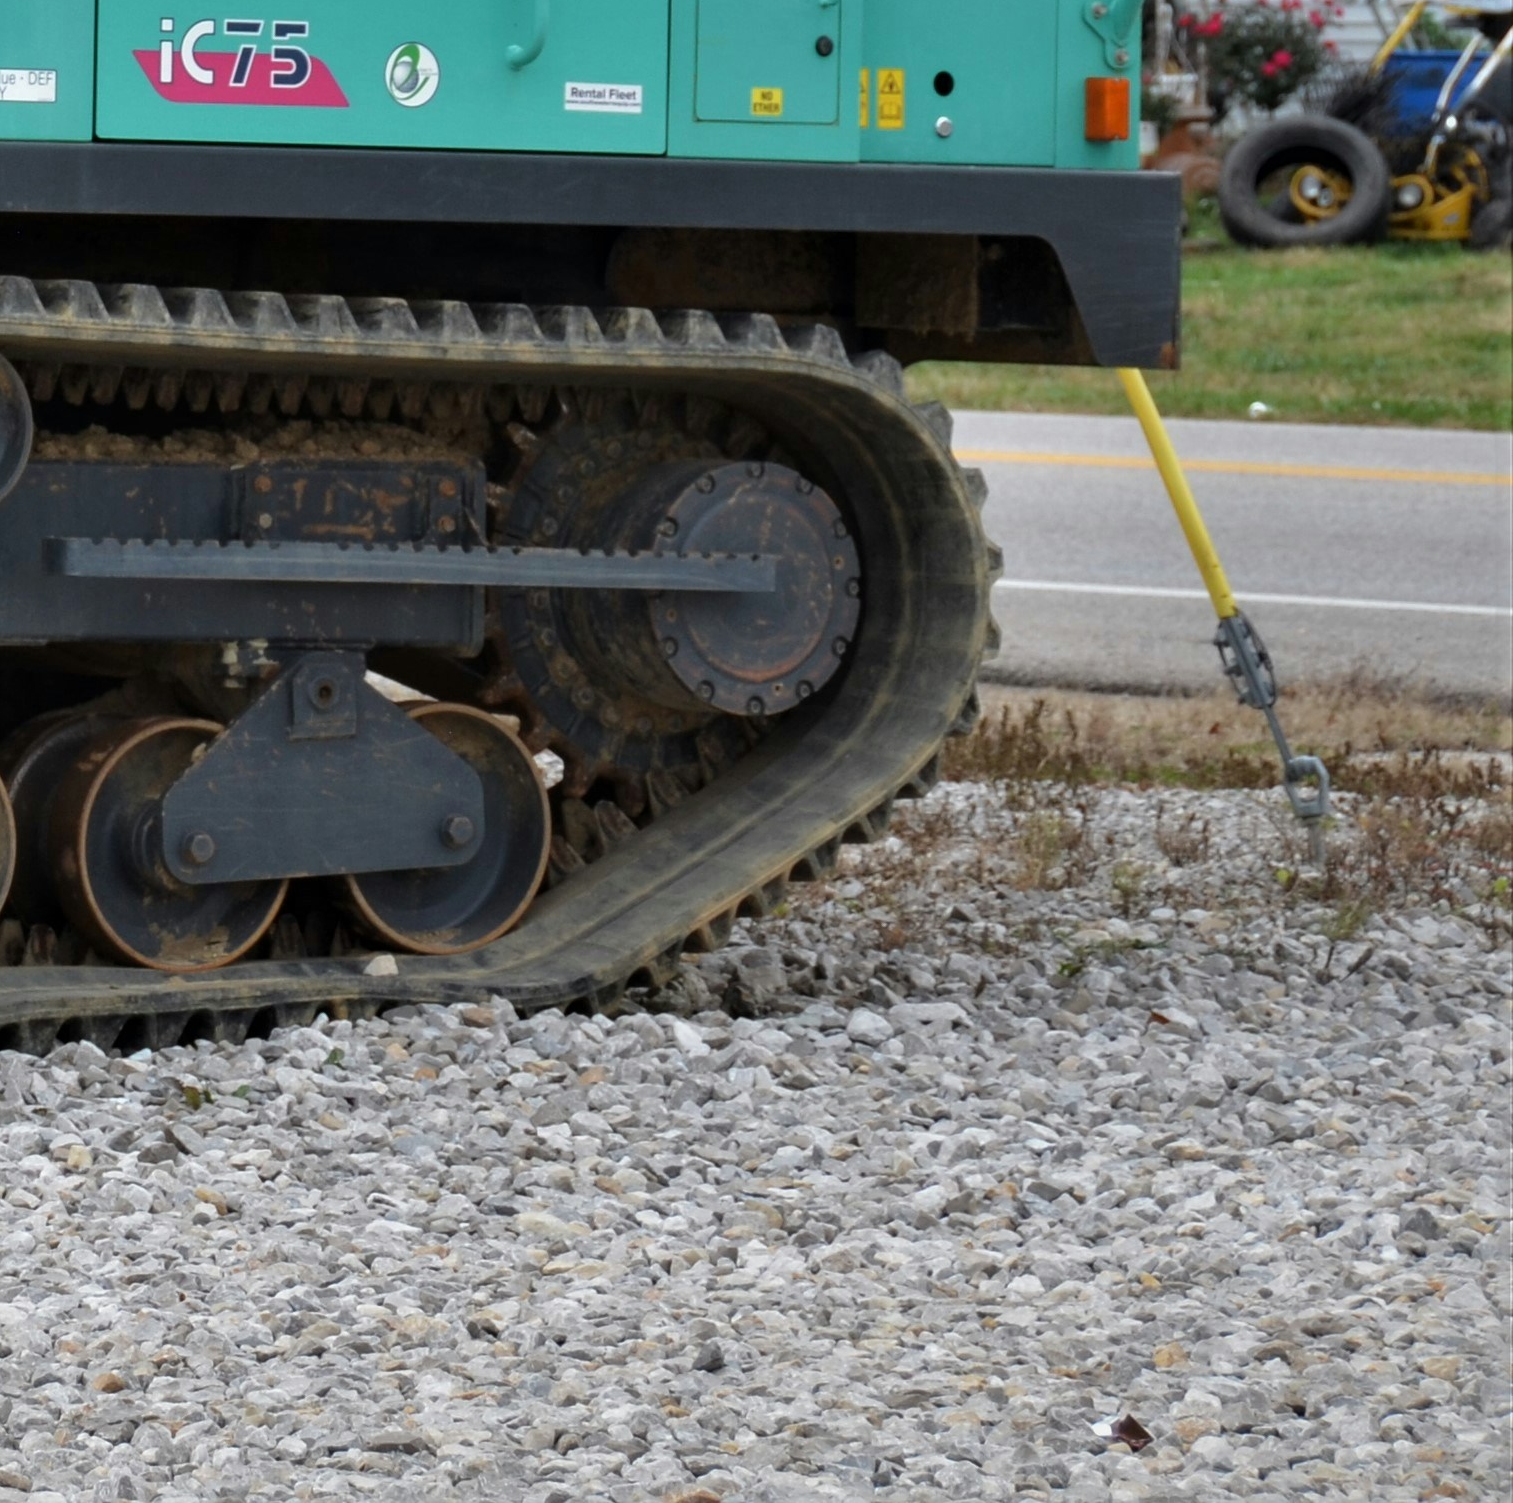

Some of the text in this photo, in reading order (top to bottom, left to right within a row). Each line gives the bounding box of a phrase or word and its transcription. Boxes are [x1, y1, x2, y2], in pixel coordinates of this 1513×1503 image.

[159, 16, 313, 89] iC75
[27, 71, 54, 86] DEF
[570, 86, 637, 100] Rental Fleet
[760, 90, 774, 102] NO
